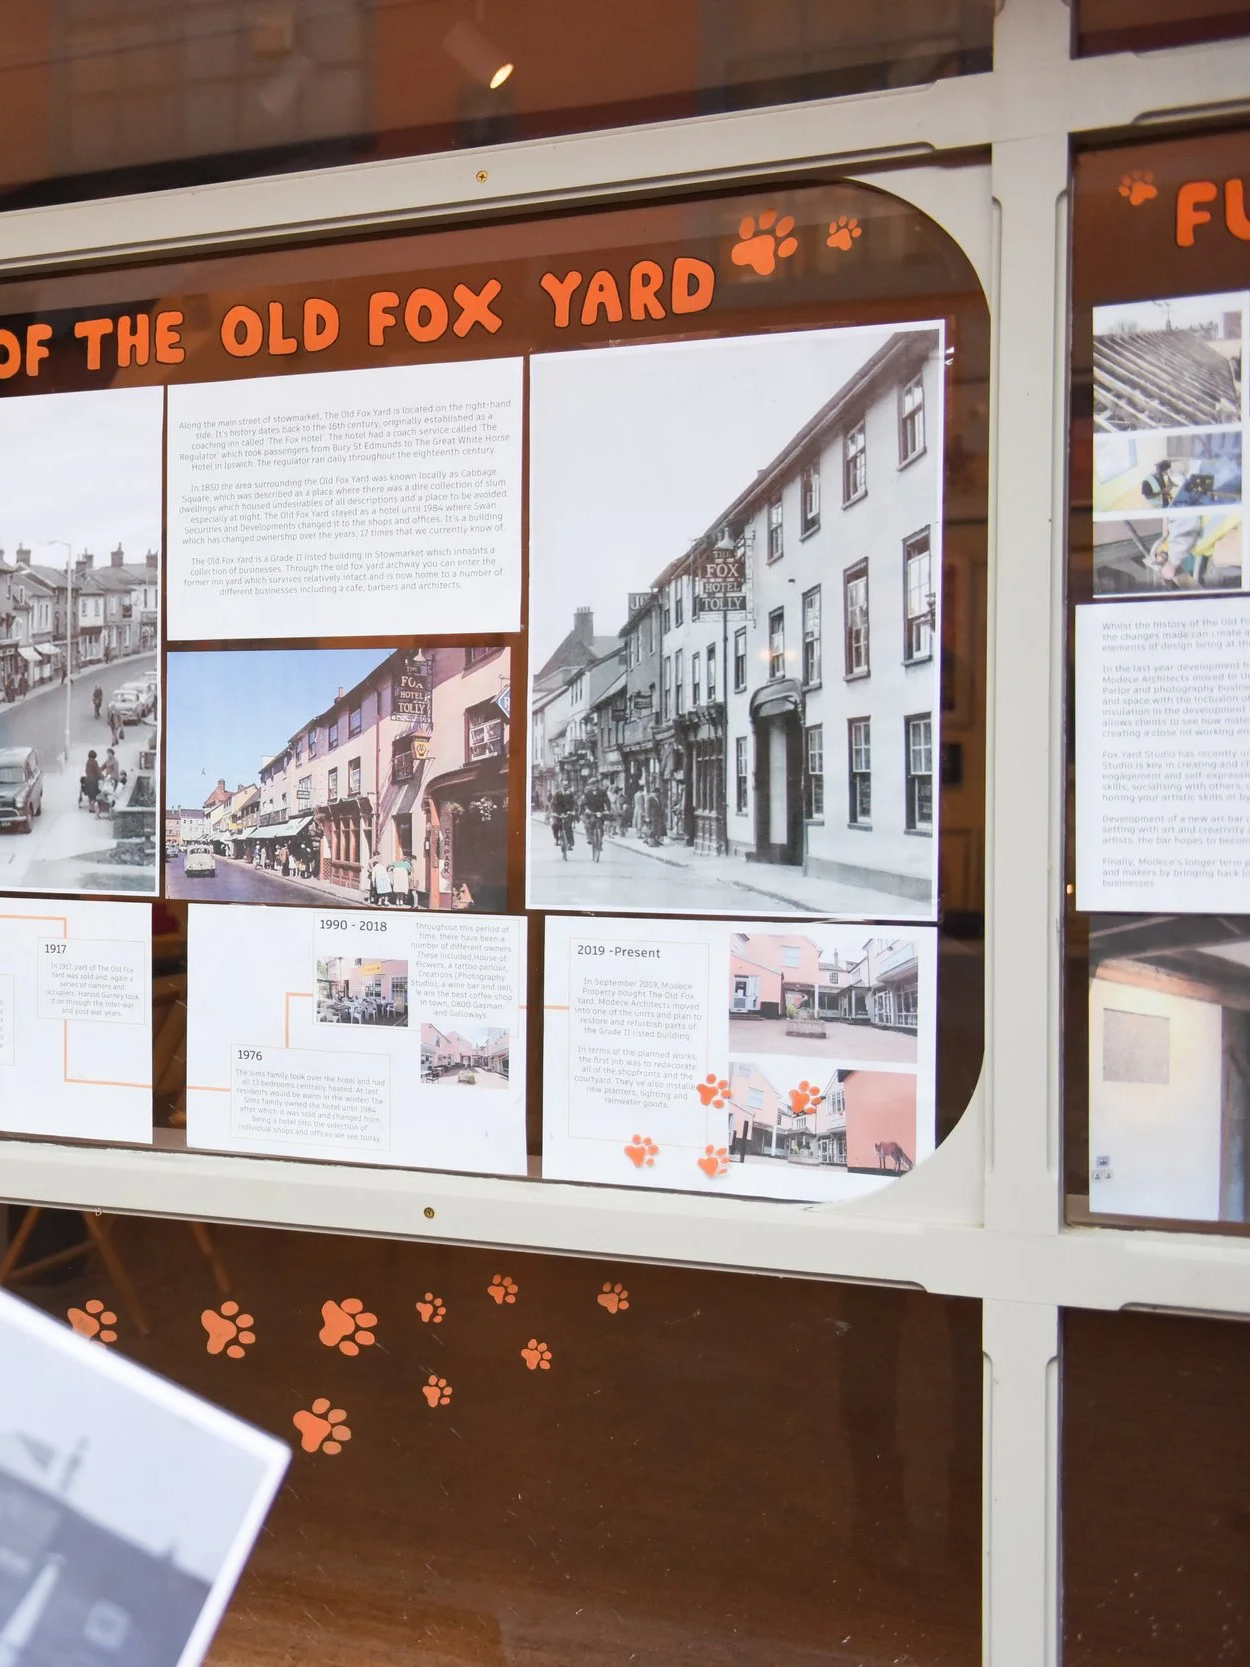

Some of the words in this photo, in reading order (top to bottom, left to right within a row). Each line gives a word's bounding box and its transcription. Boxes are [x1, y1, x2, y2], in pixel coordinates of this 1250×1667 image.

[74, 311, 185, 370] THE
[222, 298, 339, 357] OLD
[370, 279, 502, 346] FOX
[541, 257, 715, 328] YARD
[705, 563, 740, 578] FOX
[705, 582, 741, 593] HOTEL
[702, 597, 743, 611] TOLLY
[400, 690, 424, 700] HOTEL
[398, 702, 426, 714] TOLLY
[320, 919, 348, 930] 1990
[359, 920, 387, 932] 2018
[45, 944, 67, 954] 1917
[577, 944, 605, 957] 2019
[237, 1049, 263, 1061] 1976
